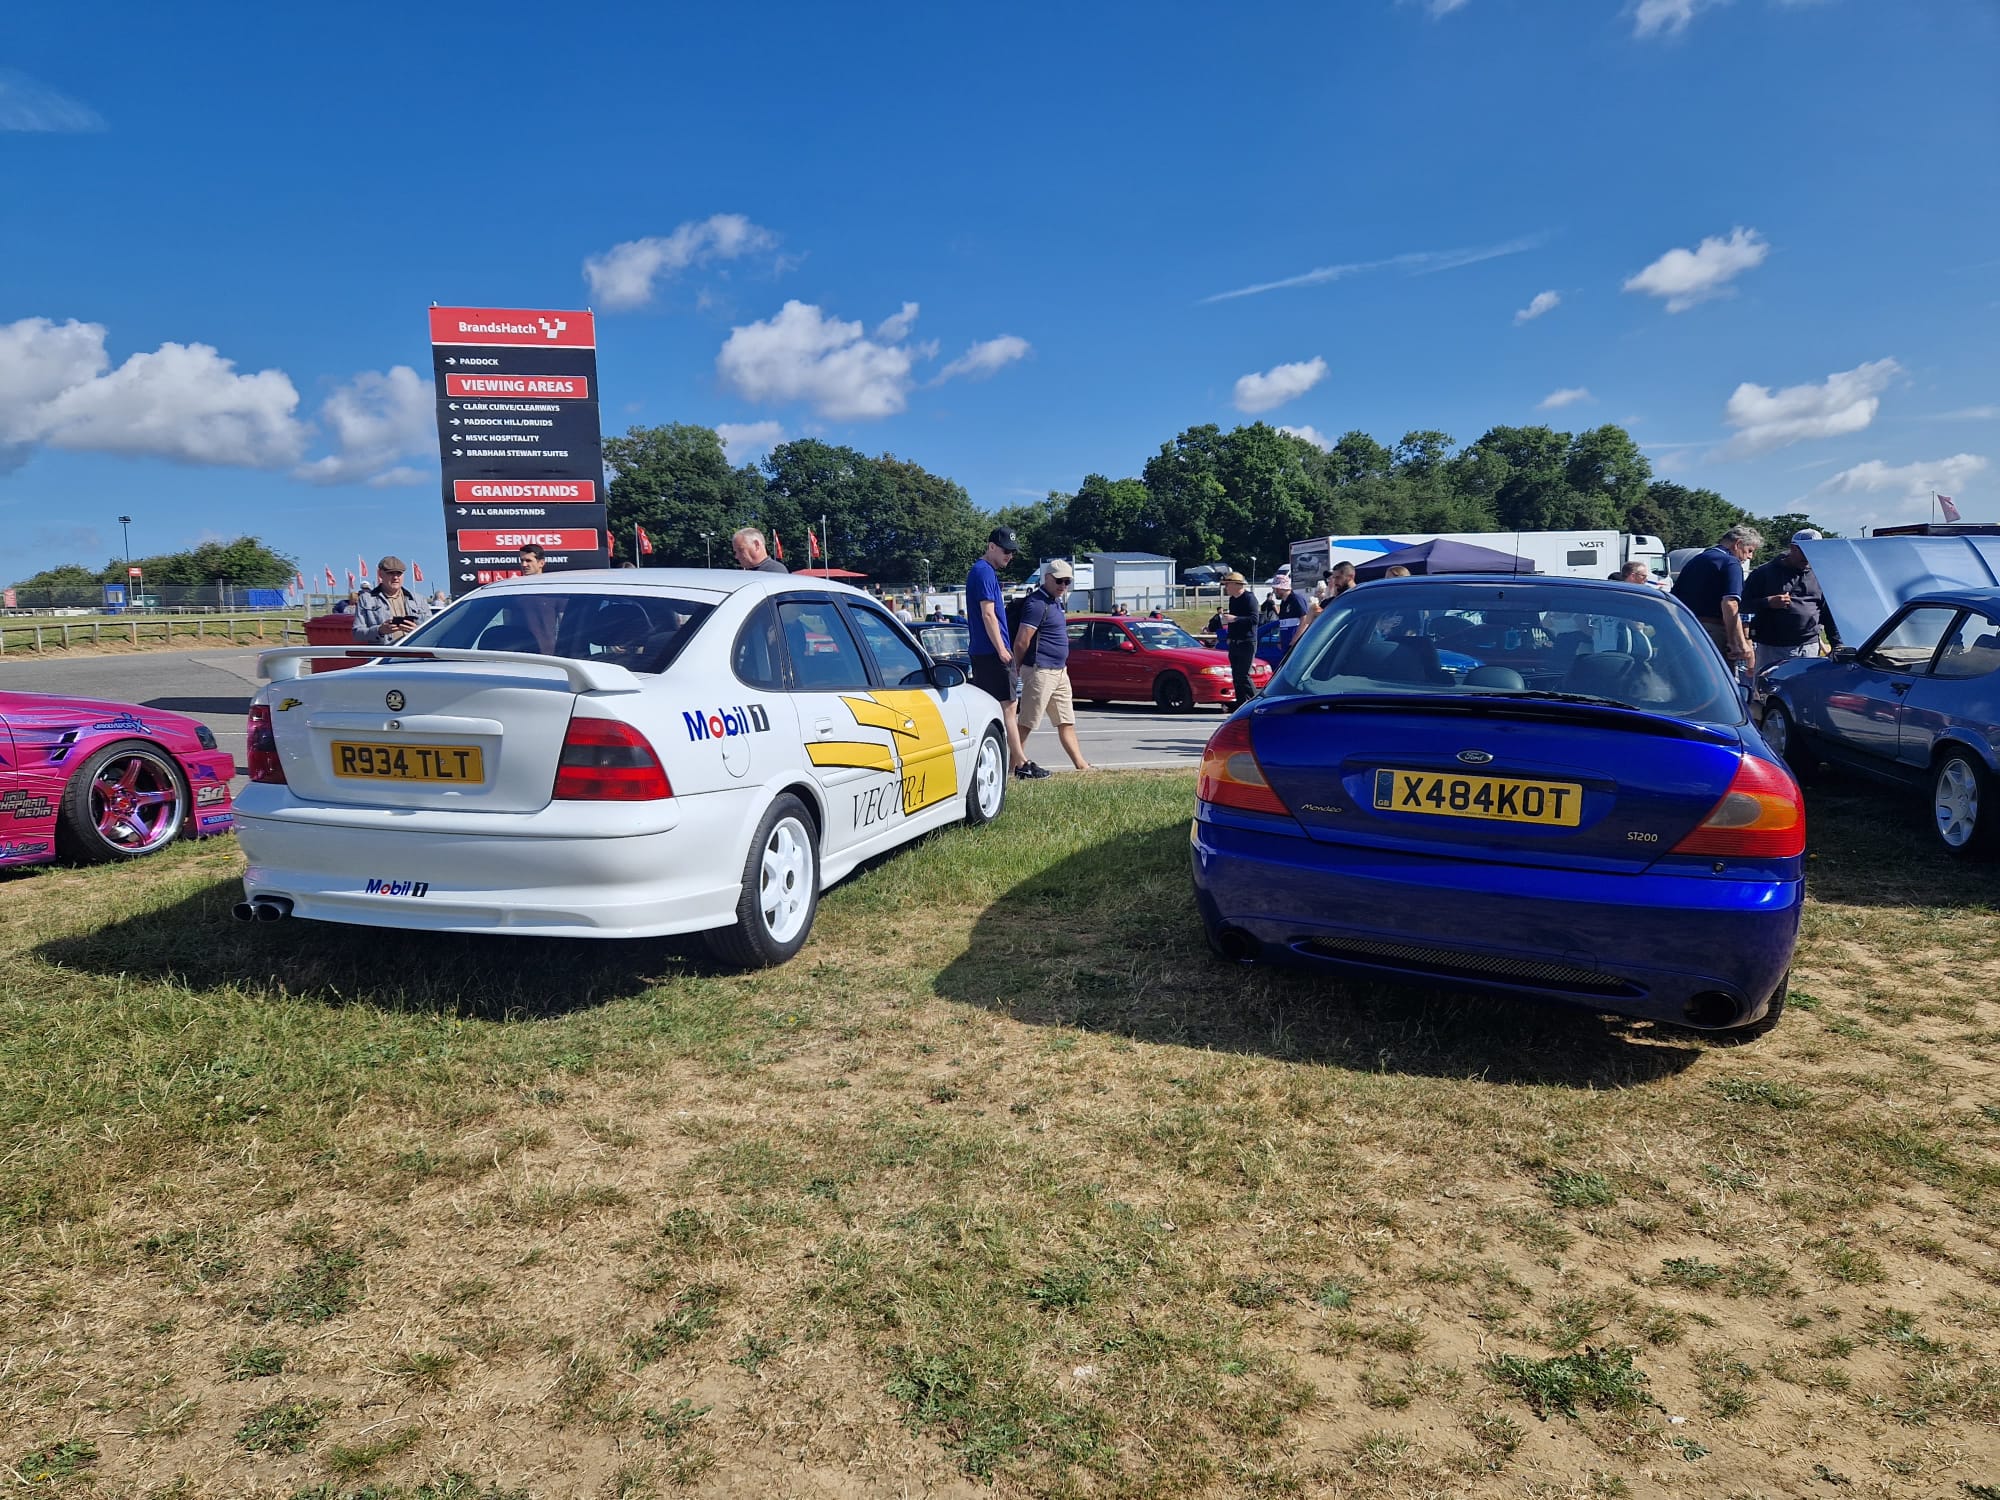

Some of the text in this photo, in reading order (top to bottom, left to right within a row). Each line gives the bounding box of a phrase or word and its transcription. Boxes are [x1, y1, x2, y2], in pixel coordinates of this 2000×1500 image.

[458, 321, 537, 334] BrandsHatch
[461, 379, 574, 393] VIEWING AREAS
[489, 404, 560, 412] CURVE/CLEARWAYS
[464, 418, 553, 427] PADDOCK HILL/DRUIDS
[465, 434, 489, 442] MSVC
[471, 485, 579, 497] GRANDSTANDS
[471, 508, 546, 516] ALL GRANDSTANDS
[495, 534, 562, 546] SERVICES
[683, 705, 750, 742] Mobil
[340, 745, 470, 779] R934 TLT
[1464, 752, 1484, 761] Ford
[852, 771, 927, 832] VECTRA
[1377, 799, 1390, 807] GB
[1401, 776, 1571, 819] X484KOT
[1301, 804, 1343, 813] Mondeo
[1627, 831, 1658, 842] ST200
[365, 878, 411, 896] Mobil
